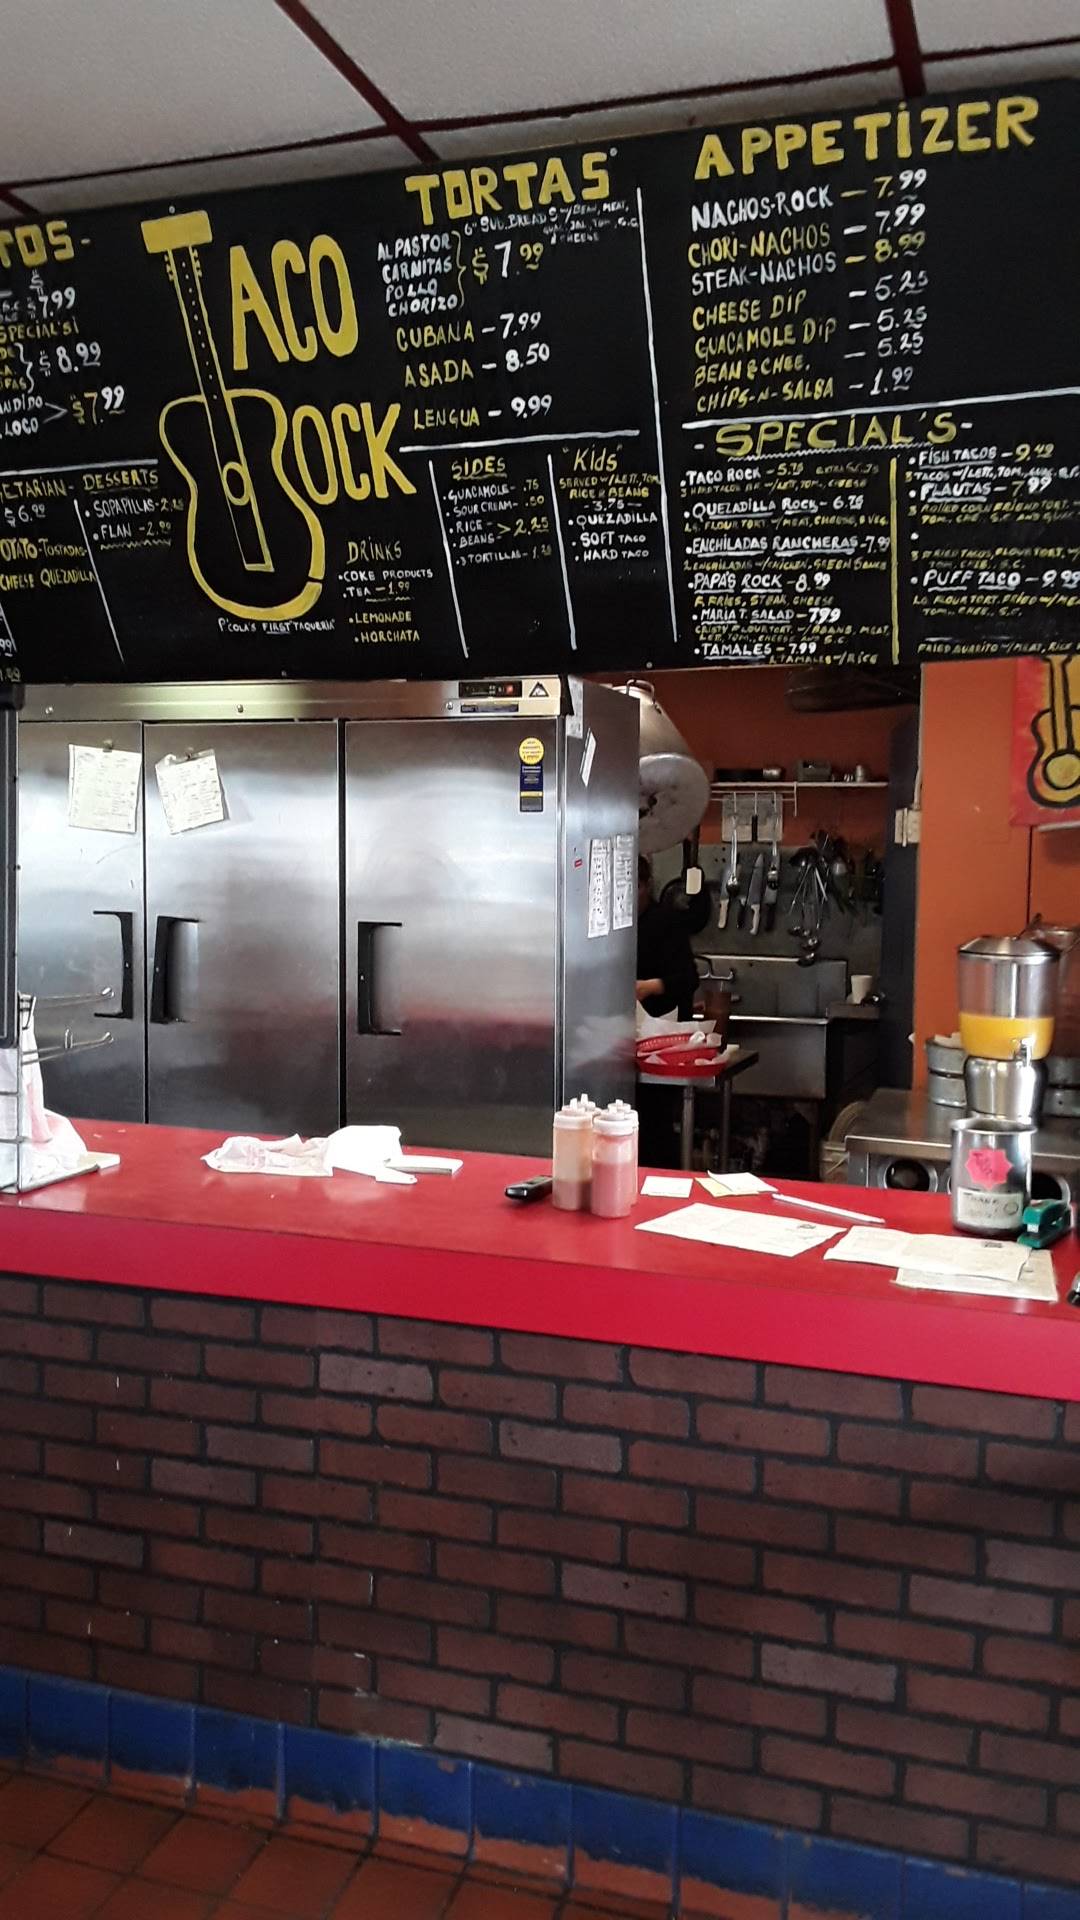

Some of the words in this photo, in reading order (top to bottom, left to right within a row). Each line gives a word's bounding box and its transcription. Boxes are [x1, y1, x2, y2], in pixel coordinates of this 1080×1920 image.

[694, 96, 1039, 181] APPETIZER
[404, 152, 610, 226] TORTAS
[873, 168, 927, 199] 7.99
[874, 203, 927, 235] 7.99
[382, 255, 453, 284] CARNITAS
[385, 278, 438, 303] POLLO
[388, 294, 458, 318] CHORIZO
[692, 299, 762, 332] CHEESE
[769, 288, 808, 320] DIP
[396, 320, 475, 351] CUBANA
[499, 312, 541, 339] 7.99
[694, 327, 797, 363] GUACAMOLE
[803, 317, 838, 345] DIP
[404, 359, 474, 388] ASADA
[505, 343, 550, 372] 8.50
[694, 361, 742, 389] BEAN
[413, 407, 480, 430] LENGUA
[510, 394, 552, 418] 9.99
[919, 446, 950, 467] FISH
[452, 456, 506, 480] SIDES
[686, 469, 723, 486] TACO
[727, 467, 762, 483] ROCK
[83, 469, 159, 491] DESSERTS
[920, 482, 991, 501] FLAUTAS
[453, 504, 479, 518] SOUR
[692, 498, 777, 523] QUEZADILLA
[781, 497, 818, 514] ROCK
[101, 523, 132, 539] FLAN
[456, 519, 483, 533] RICE
[576, 511, 658, 531] QUEZADILLA
[346, 536, 402, 563] DRINKS
[459, 532, 495, 548] BEANS
[580, 531, 615, 548] SOFT
[618, 534, 647, 545] TACO
[692, 534, 768, 554] ENCHILADAS
[772, 536, 858, 551] RANCHERAS
[583, 549, 618, 562] HARD
[621, 550, 650, 560] TACO
[343, 570, 375, 581] COKE
[382, 568, 434, 580] PRODUCTS
[741, 573, 783, 589] ROCK
[923, 569, 974, 587] PUFF
[978, 571, 1021, 588] TACO
[355, 611, 412, 624] LEMONADE
[701, 607, 736, 621] MARIA
[751, 609, 795, 620] SALAD
[361, 630, 421, 643] HORCHATA
[701, 643, 772, 656] TAMALES
